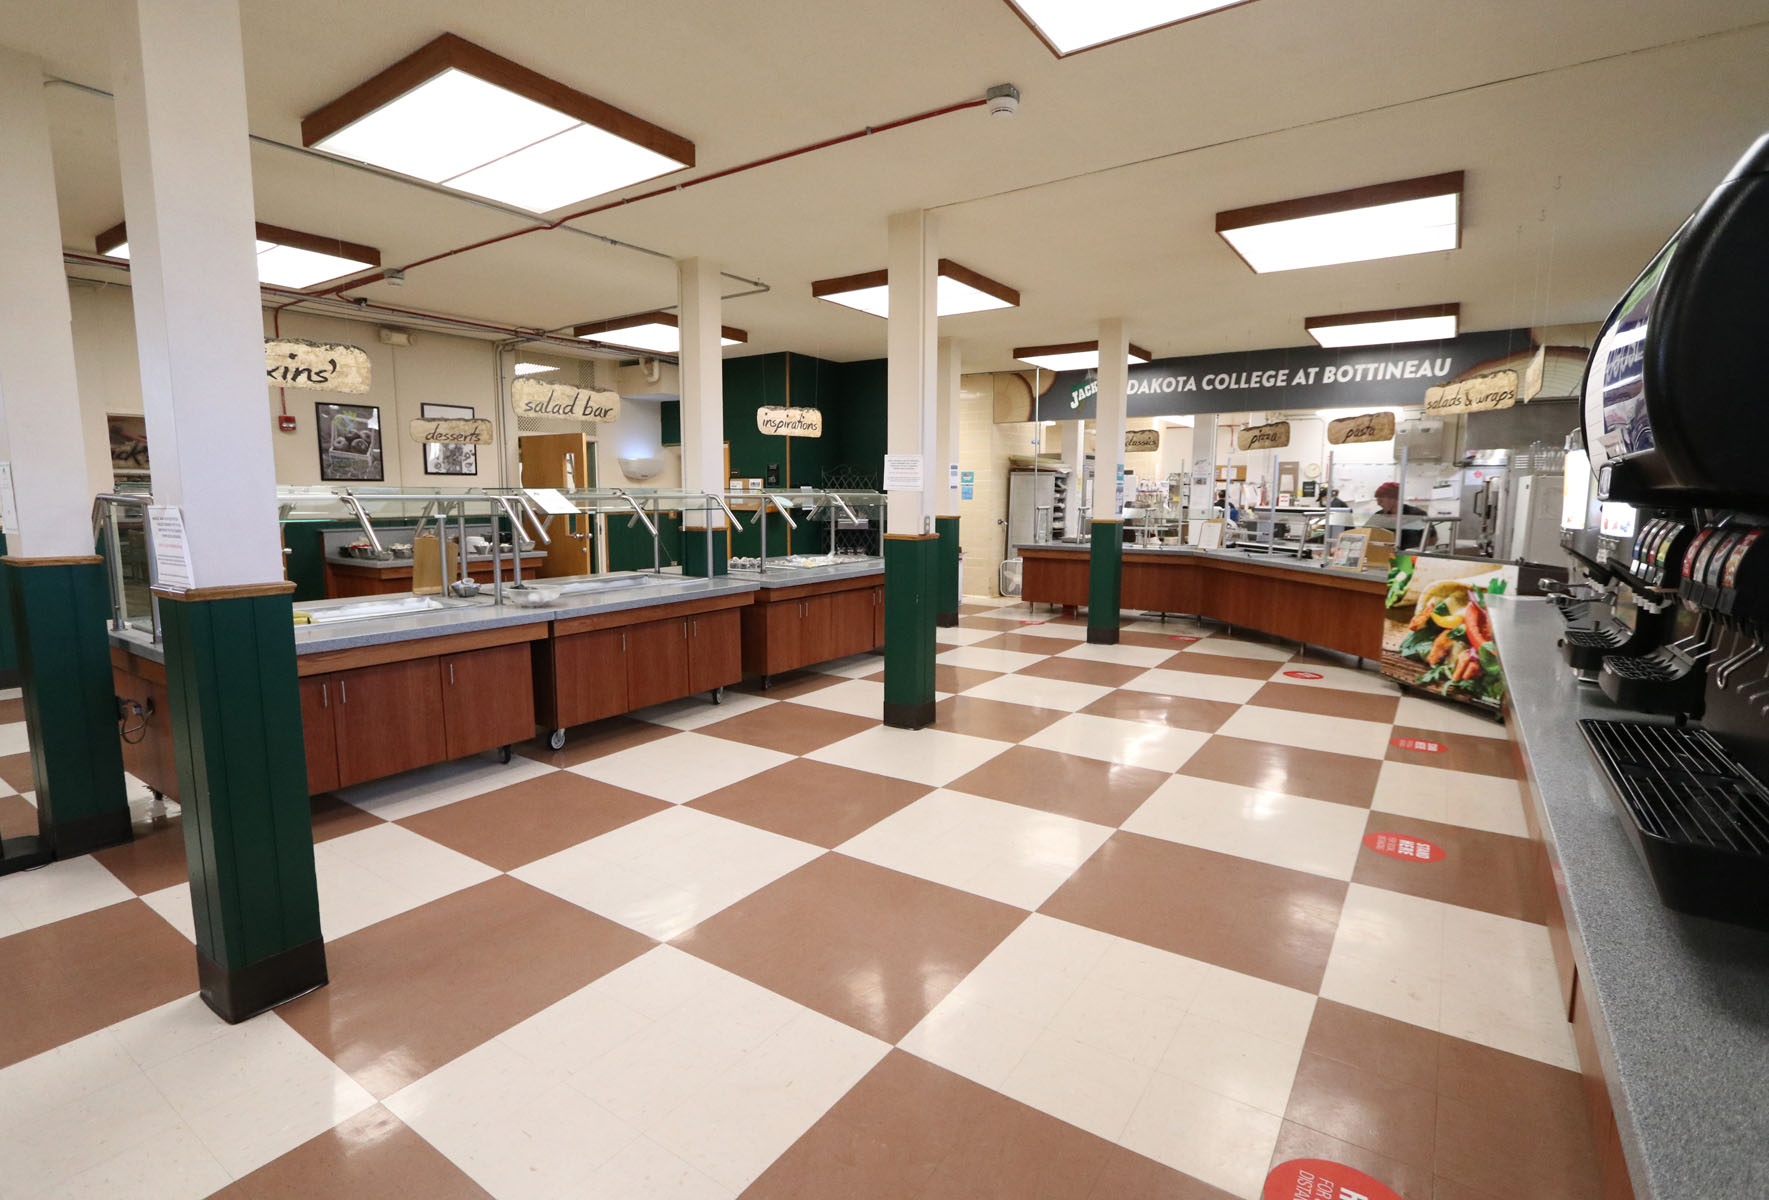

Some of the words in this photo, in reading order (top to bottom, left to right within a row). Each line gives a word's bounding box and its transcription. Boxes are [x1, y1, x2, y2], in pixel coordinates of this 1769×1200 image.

[1127, 376, 1197, 395] DAKOTA
[1202, 368, 1289, 391] COLLEGE
[1292, 367, 1319, 386] AT
[1323, 357, 1452, 385] BOTTINEAU
[524, 390, 577, 415] salad
[582, 395, 614, 418] bar
[1426, 387, 1461, 410] salads
[1464, 391, 1473, 407] &
[1475, 389, 1515, 408] wraps
[425, 423, 481, 442] desserts
[762, 411, 818, 434] inspirations
[1342, 417, 1376, 444] pasta
[1247, 429, 1279, 450] pizza
